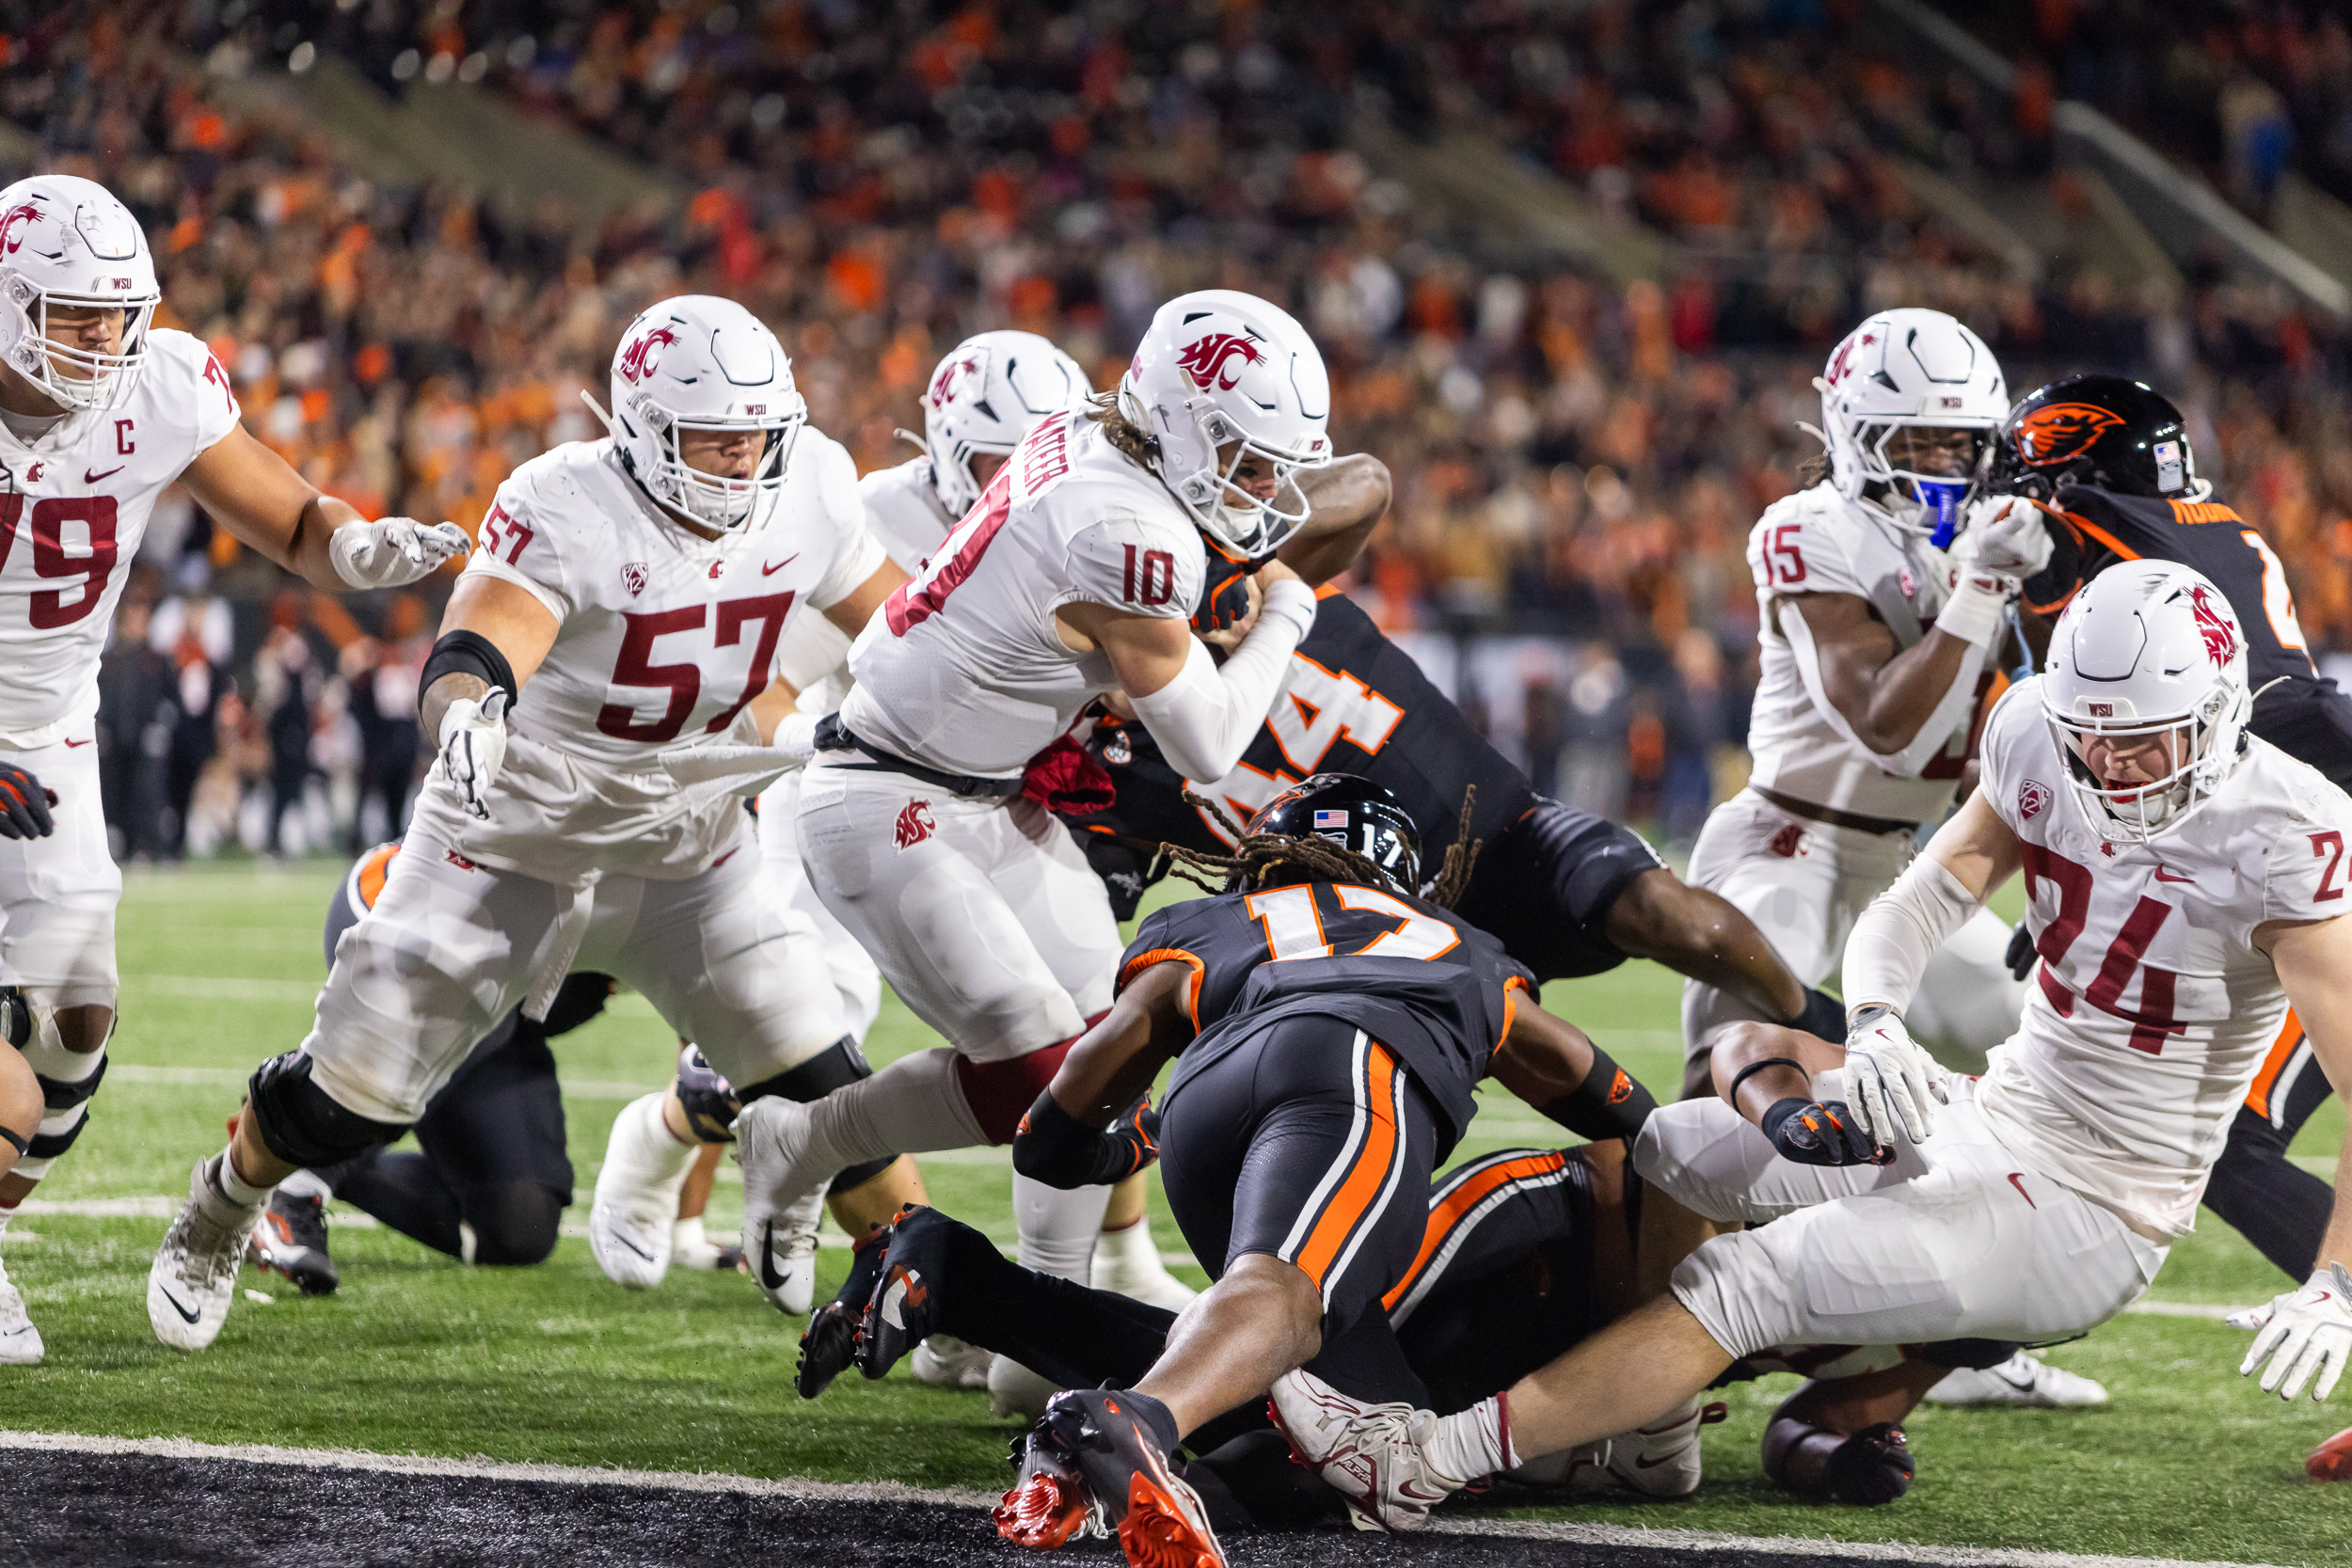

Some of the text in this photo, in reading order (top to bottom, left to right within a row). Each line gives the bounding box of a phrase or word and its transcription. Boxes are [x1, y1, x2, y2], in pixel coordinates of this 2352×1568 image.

[113, 277, 132, 290] WSU
[202, 341, 234, 414] 7
[115, 419, 135, 454] C
[746, 404, 767, 416] WSU
[481, 502, 534, 567] 57
[884, 457, 1011, 638] 0
[1762, 524, 1806, 586] 15
[629, 577, 644, 593] 12
[1121, 542, 1174, 605] 10
[596, 589, 797, 743] 57
[2088, 703, 2114, 717] WSU
[2021, 796, 2041, 815] 12
[1360, 822, 1404, 869] 17
[2306, 830, 2352, 904] 2
[1244, 882, 1463, 966] 17
[2019, 835, 2189, 1056] 24
[1342, 1459, 1373, 1485] ALPHA
